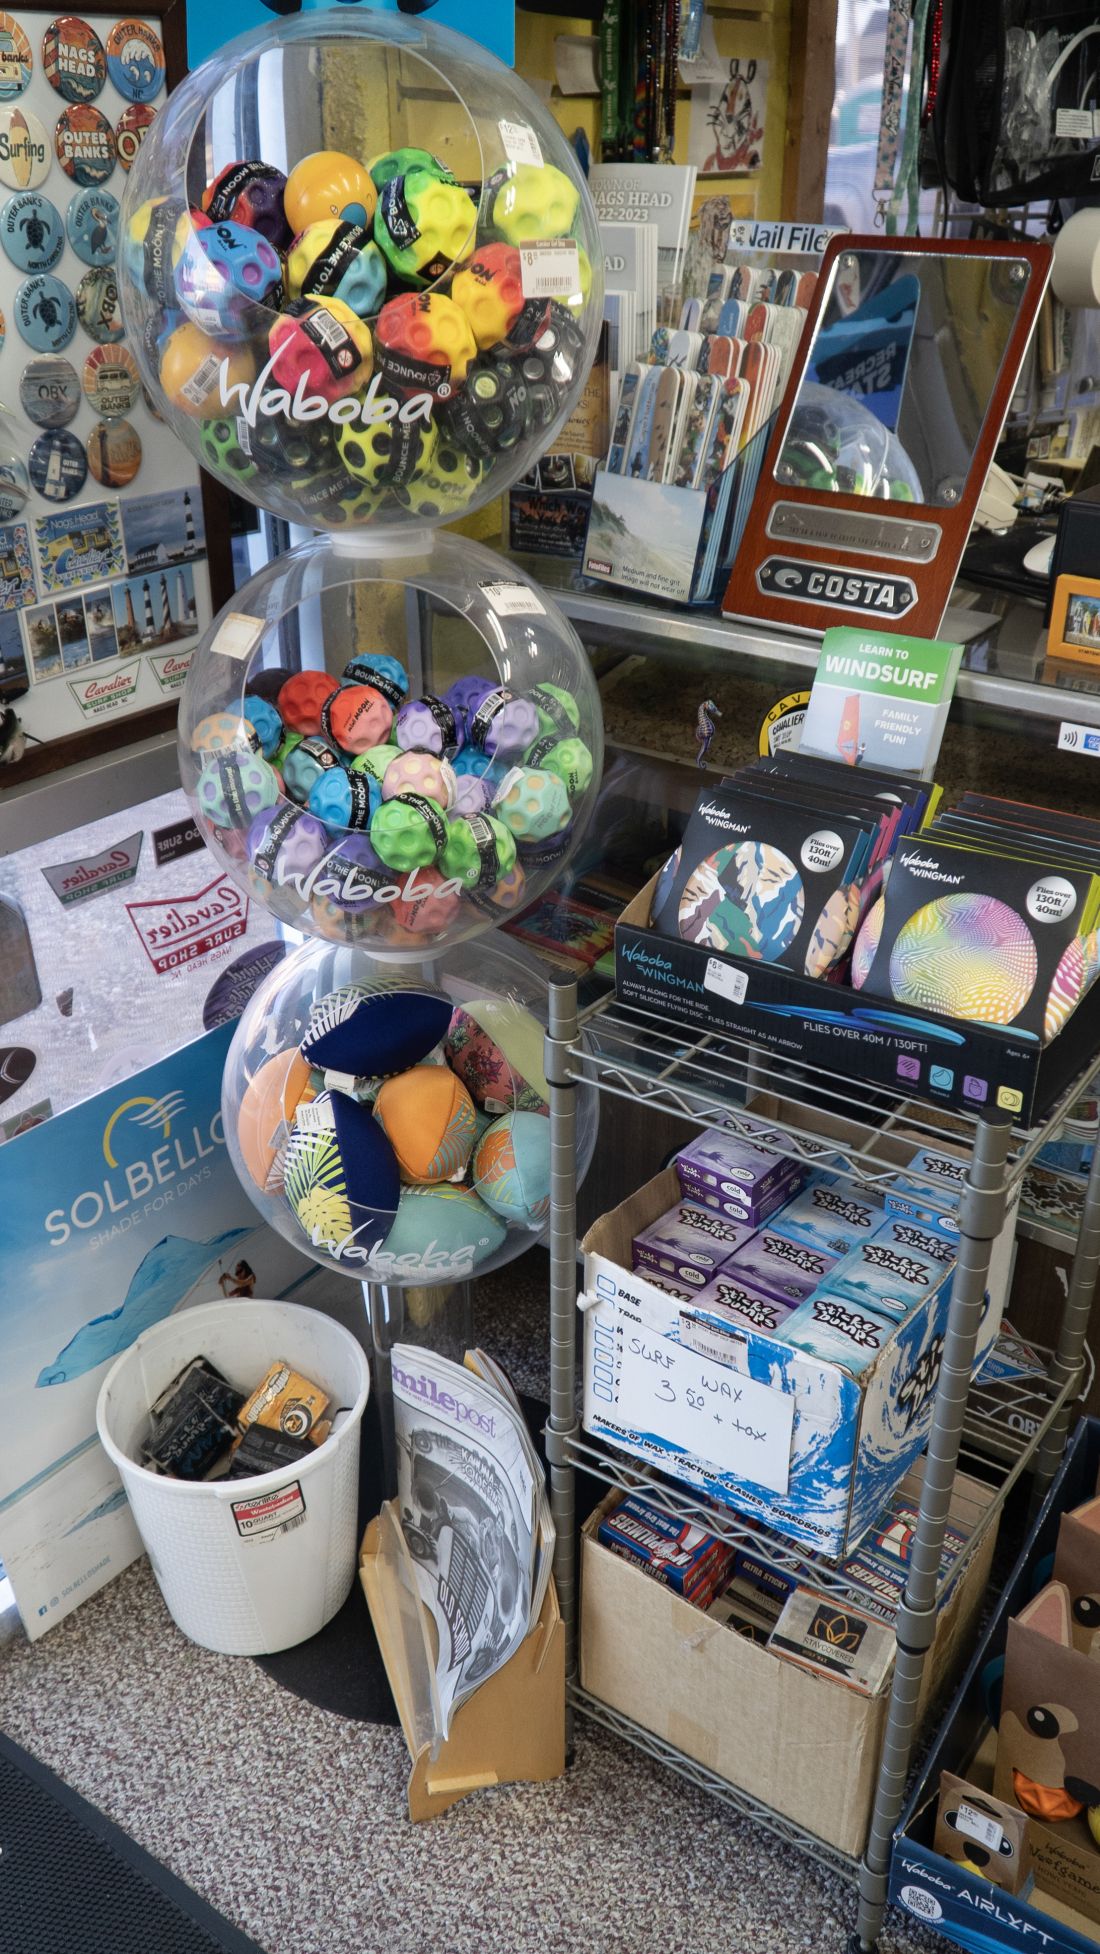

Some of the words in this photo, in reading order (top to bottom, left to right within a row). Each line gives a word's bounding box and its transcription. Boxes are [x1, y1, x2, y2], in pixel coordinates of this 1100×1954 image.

[1, 52, 29, 63] banks
[58, 43, 96, 64] NAGS
[58, 58, 96, 77] HEAD
[132, 88, 144, 99] NC
[0, 133, 45, 163] Surfing
[63, 131, 108, 145] OUTER
[64, 145, 110, 159] BANKS
[223, 167, 249, 195] MOON
[625, 178, 641, 191] OF
[626, 191, 673, 207] HEAD
[7, 206, 20, 233] OUTER
[76, 201, 91, 228] OUTER
[325, 247, 344, 265] ME
[319, 265, 333, 282] TO
[25, 278, 46, 298] BANKS
[20, 299, 31, 327] OUTER
[97, 284, 118, 331] OBX
[219, 331, 436, 428] Waboba
[51, 518, 72, 530] Nags
[74, 511, 99, 522] Head
[621, 574, 639, 587] Image
[639, 578, 650, 588] will
[650, 581, 660, 590] not
[622, 565, 645, 577] Medium
[658, 572, 671, 583] fine
[671, 576, 681, 587] grit
[806, 572, 895, 608] COSTA
[859, 643, 893, 658] LEARN
[895, 649, 910, 660] TO
[825, 654, 939, 690] WINDSURF
[85, 674, 133, 699] Cavalier
[86, 696, 108, 710] SURF
[110, 688, 133, 700] SHOP
[106, 701, 119, 709] HEAD
[354, 698, 370, 721] MOON
[772, 713, 805, 736] CAVALIER
[882, 709, 919, 723] FAMILY
[874, 719, 923, 736] FRIENDLY
[883, 734, 907, 745] FUN!
[360, 777, 368, 809] MOON!
[356, 809, 365, 828] THE
[698, 800, 731, 819] Waboba
[705, 815, 748, 834] WINGMAN
[808, 846, 831, 858] 130ft
[810, 838, 826, 846] Flies
[826, 843, 841, 851] over
[808, 855, 831, 868] 40m!
[900, 849, 940, 870] Waboba
[278, 839, 463, 903] Waboba
[909, 867, 961, 885] WINGMAN
[1035, 886, 1054, 894] Flies
[1055, 891, 1072, 899] over
[1035, 893, 1062, 906] 130ft
[1035, 904, 1063, 917] 40m!
[622, 941, 672, 971] Waboba
[636, 964, 704, 994] WINGMAN
[623, 980, 646, 991] ALWAYS
[647, 987, 668, 999] ALONG
[668, 993, 682, 1002] FOR
[682, 998, 694, 1007] THE
[623, 988, 638, 998] SOFT
[639, 993, 667, 1007] SILICONE
[667, 1002, 688, 1014] FLYING
[689, 1008, 704, 1019] DISC
[708, 1015, 725, 1026] FLIES
[725, 1020, 757, 1036] STRAIGHT
[757, 1030, 767, 1039] AS
[767, 1033, 778, 1042] AN
[778, 1036, 803, 1050] ARROW
[803, 1021, 831, 1034] FLIES
[832, 1026, 860, 1040] OVER
[862, 1031, 884, 1045] 40M
[886, 1036, 892, 1047] /
[894, 1037, 929, 1053] 130FT!
[726, 1184, 742, 1196] cold
[89, 1213, 143, 1250] SHADE
[143, 1190, 175, 1217] FOR
[176, 1166, 212, 1203] DAYS
[729, 1204, 743, 1215] cold
[312, 1219, 476, 1268] Waboba
[684, 1269, 700, 1280] cold
[617, 1289, 643, 1307] BASE
[628, 1337, 676, 1370] SURF
[701, 1375, 744, 1403] WAX
[391, 1363, 497, 1439] milepost
[654, 1379, 677, 1403] 3
[592, 1414, 627, 1436] MAKERS
[628, 1432, 641, 1443] OF
[643, 1440, 665, 1455] WAX
[673, 1454, 718, 1482] TRACTION
[724, 1480, 764, 1507] LEASHES
[771, 1505, 832, 1538] BOARDBAGS
[241, 1520, 253, 1530] 10
[742, 1560, 763, 1579] ULTRA
[763, 1571, 789, 1592] STICKY
[440, 1580, 455, 1619] OLD
[802, 1636, 855, 1665] STAYCOVERED
[901, 1859, 952, 1891] Waboba
[956, 1888, 1055, 1946] AIRLYFT
